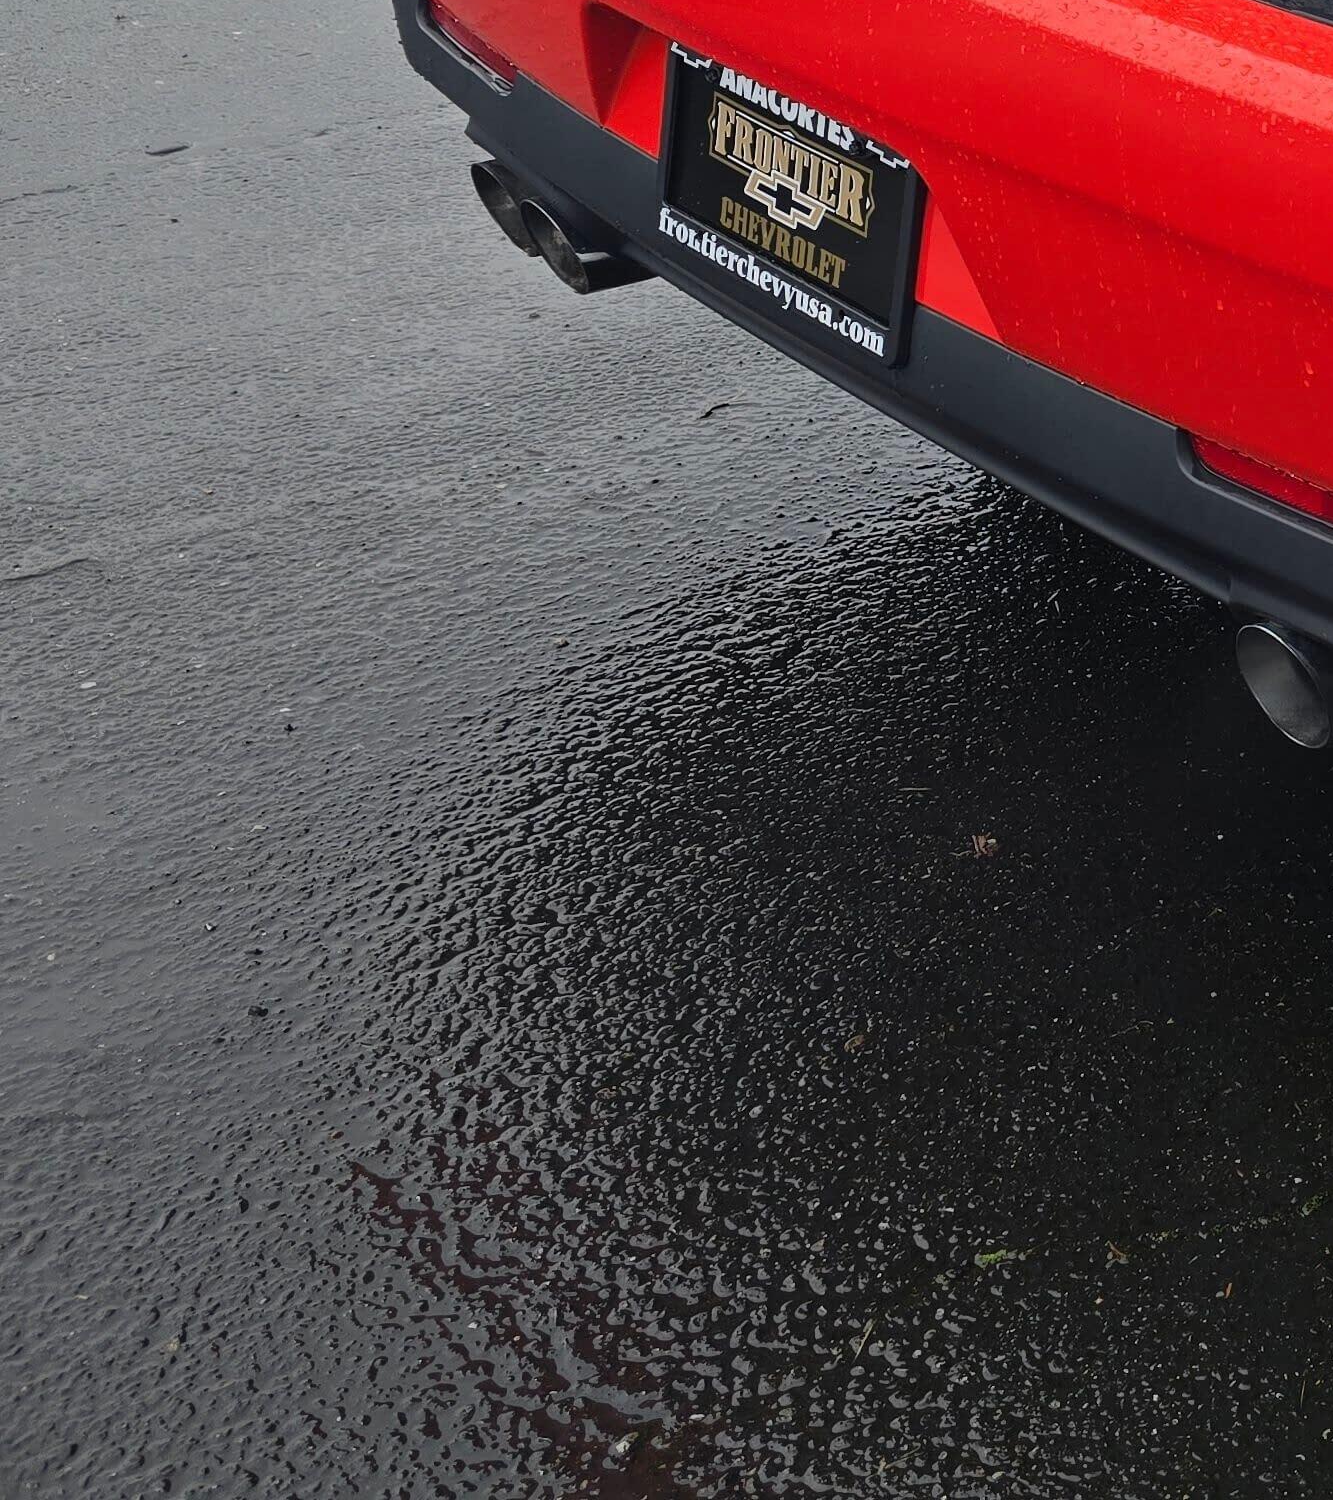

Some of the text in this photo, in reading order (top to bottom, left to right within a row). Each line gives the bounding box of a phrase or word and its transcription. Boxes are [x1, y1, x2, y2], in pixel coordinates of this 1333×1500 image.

[719, 66, 855, 150] ANACORTES
[714, 100, 865, 227] FRONTIER
[719, 195, 847, 289] CHEVROLET
